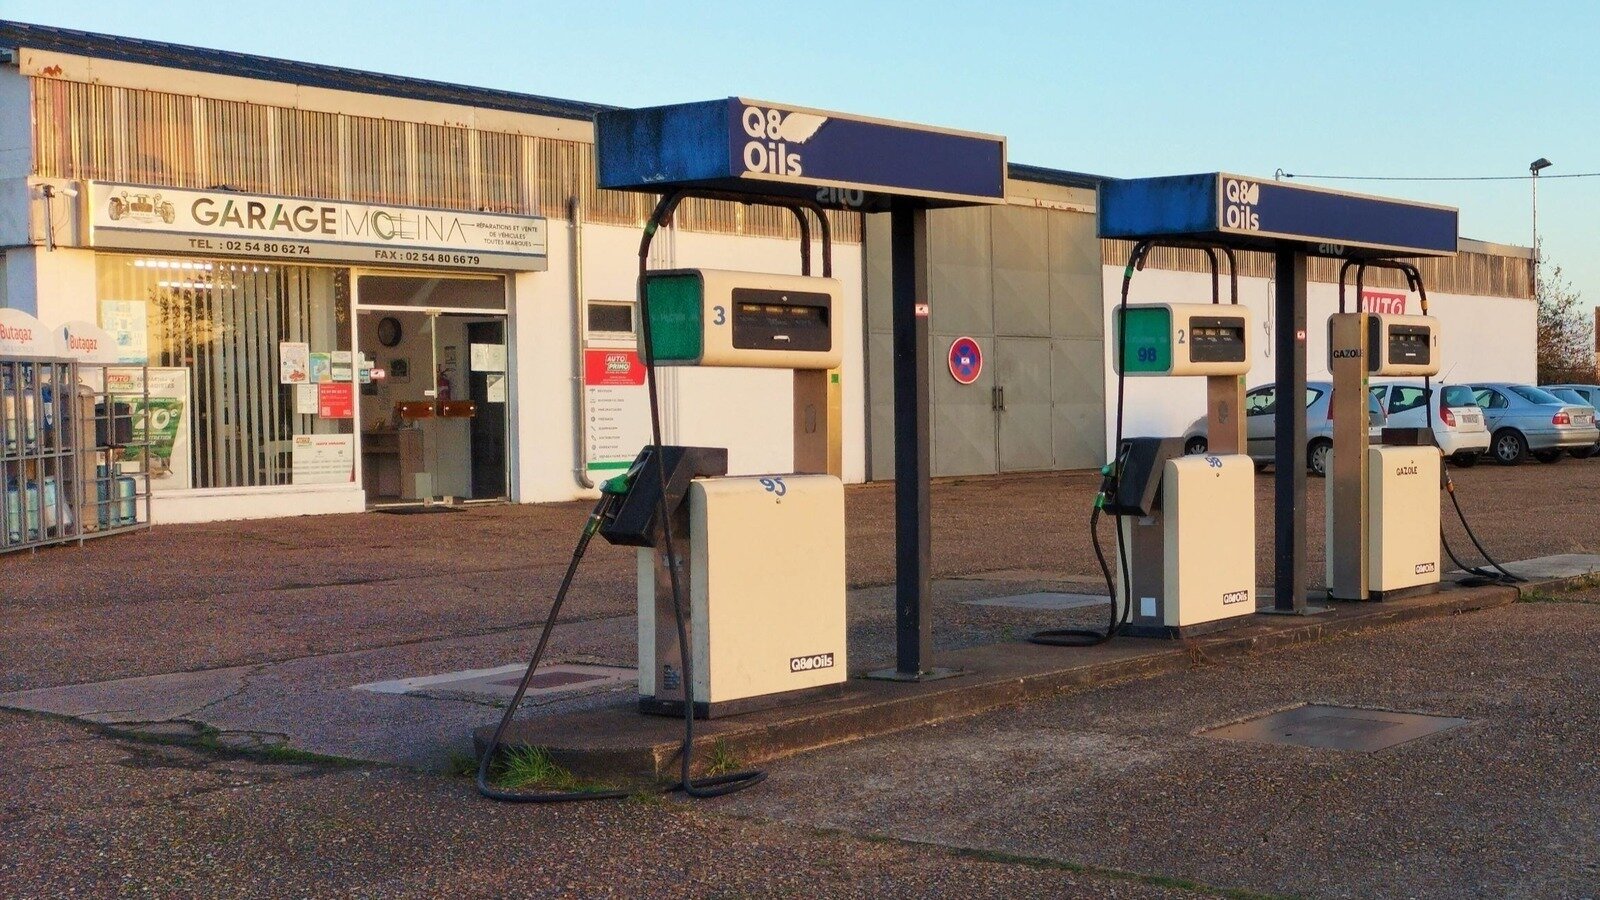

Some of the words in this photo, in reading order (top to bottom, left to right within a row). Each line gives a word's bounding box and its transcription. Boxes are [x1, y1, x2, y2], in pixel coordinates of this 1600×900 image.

[742, 106, 782, 140] Q8
[743, 141, 802, 177] Oils
[1226, 179, 1249, 204] Q8
[191, 197, 337, 235] GARAGE
[345, 208, 467, 243] MOLINA
[1226, 205, 1259, 231] Oils
[188, 238, 213, 249] TEL
[226, 240, 241, 251] 02
[245, 242, 260, 252] 54
[263, 243, 278, 253] 80
[281, 244, 296, 254] 62
[297, 245, 310, 255] 74
[484, 238, 504, 246] TOUTES
[505, 239, 532, 247] MARQUES
[374, 249, 397, 260] FAX
[405, 251, 419, 262] 02
[421, 253, 435, 262] 54
[437, 254, 451, 263] 80
[453, 254, 466, 264] 66
[467, 255, 480, 265] 79
[1361, 296, 1403, 315] AUTO
[712, 305, 726, 326] 3
[0, 323, 32, 344] Butagaz
[1178, 329, 1186, 344] 2
[1433, 334, 1437, 348] 1
[70, 334, 98, 353] Butagaz
[607, 355, 626, 363] AUTO
[1138, 347, 1157, 362] 98
[1333, 349, 1363, 358] GAZOL
[608, 362, 629, 370] PRIMO
[1396, 466, 1418, 476] GAZOLE
[760, 477, 787, 497] 95
[791, 657, 807, 671] Q8
[813, 654, 833, 668] Oils
